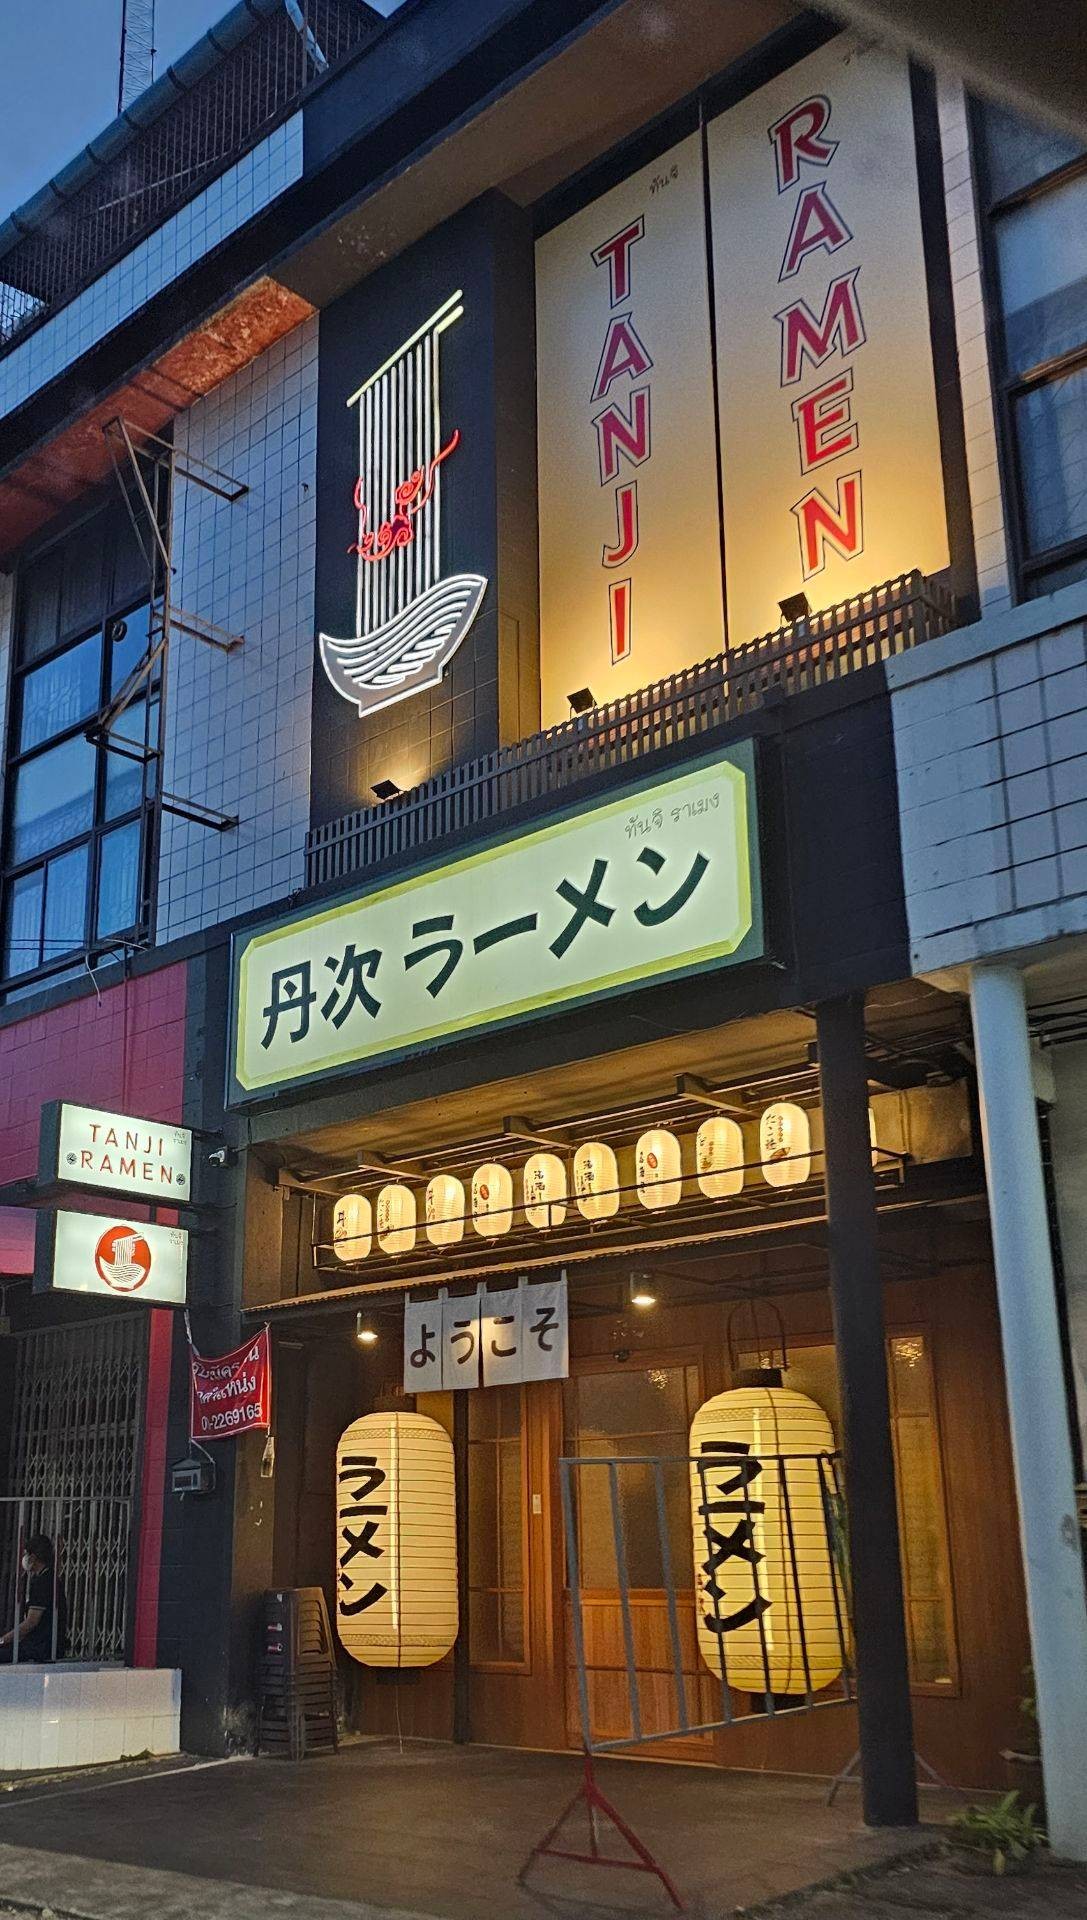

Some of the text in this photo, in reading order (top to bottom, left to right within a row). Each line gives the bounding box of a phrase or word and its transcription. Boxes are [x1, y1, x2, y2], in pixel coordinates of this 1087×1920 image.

[767, 93, 866, 582] RAMEN
[590, 214, 654, 665] TANJI
[80, 1149, 173, 1185] RAMEN
[89, 1123, 164, 1157] TANJI
[410, 1306, 559, 1369] ようこそ
[201, 1402, 263, 1431] 0-2269165
[338, 1455, 388, 1617] ラーメン
[697, 1440, 774, 1634] ラーメン
